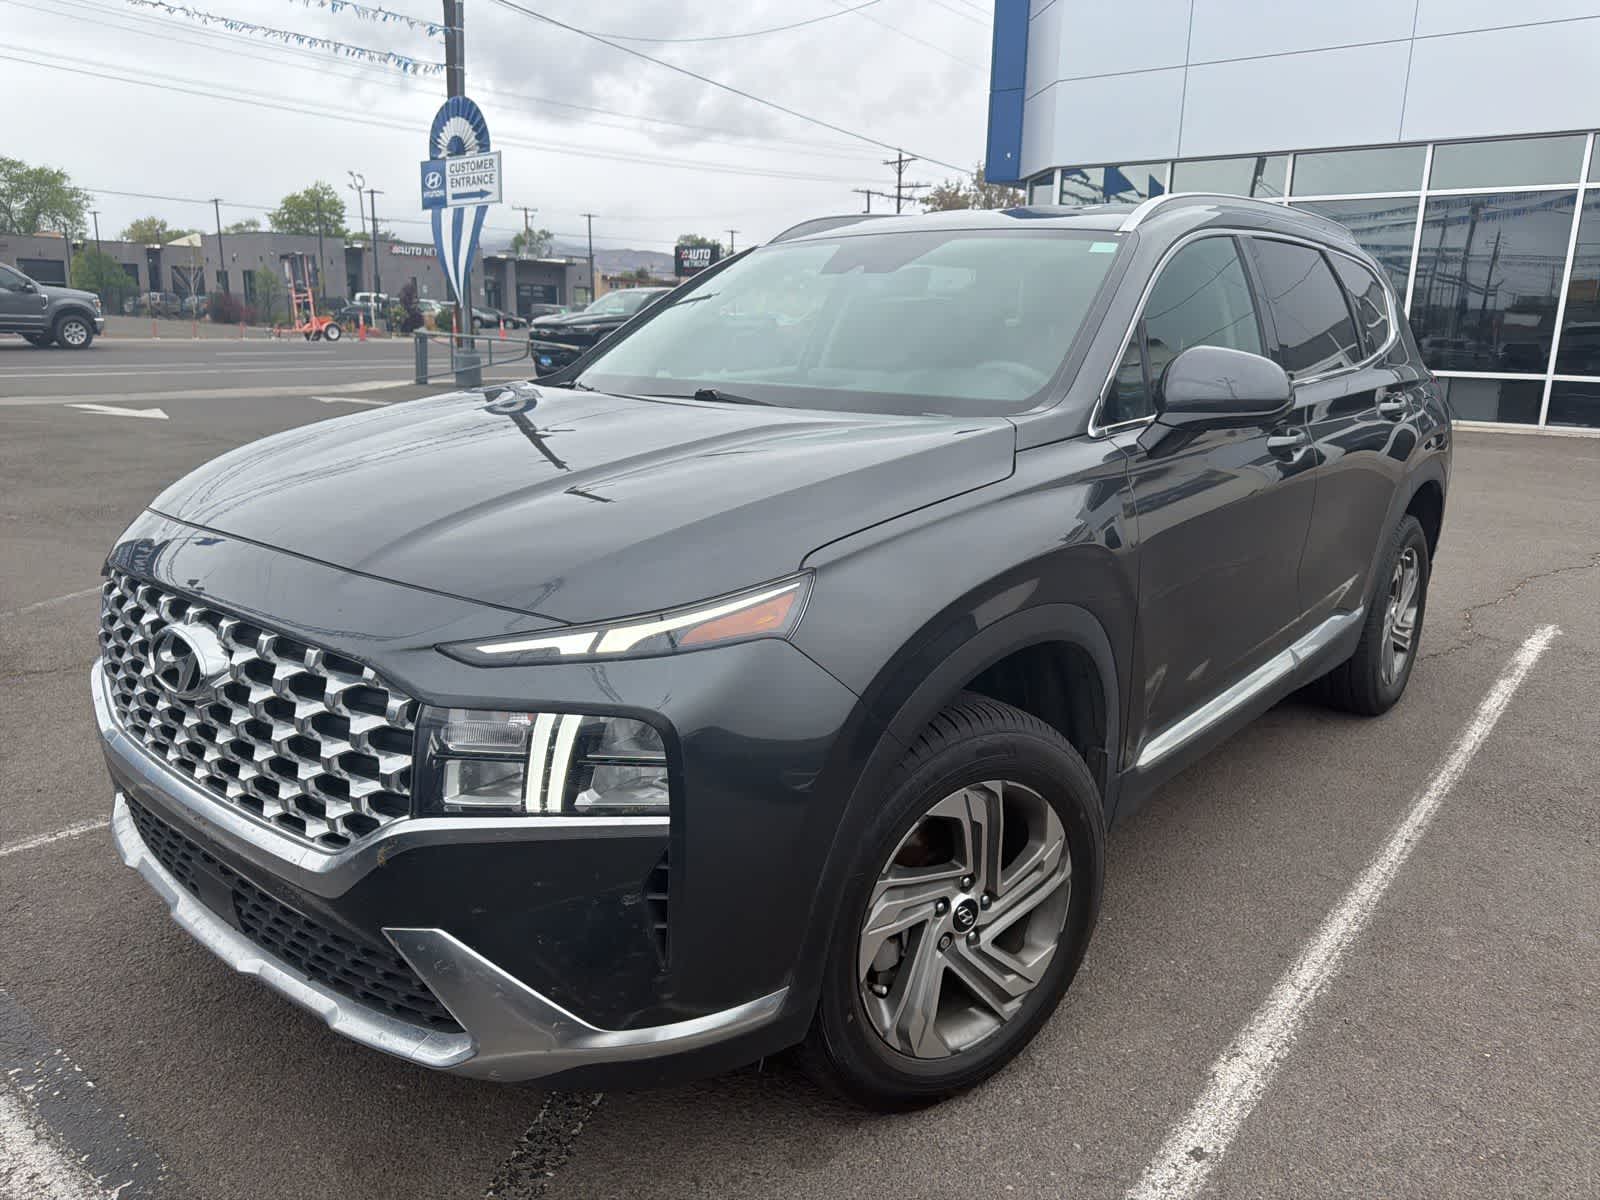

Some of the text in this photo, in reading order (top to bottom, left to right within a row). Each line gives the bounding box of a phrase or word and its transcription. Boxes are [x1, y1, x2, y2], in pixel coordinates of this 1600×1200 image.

[449, 158, 494, 174] CUSTOMER
[450, 173, 495, 188] ENTRANCE
[399, 246, 422, 256] AUTO
[688, 248, 711, 260] AUTO
